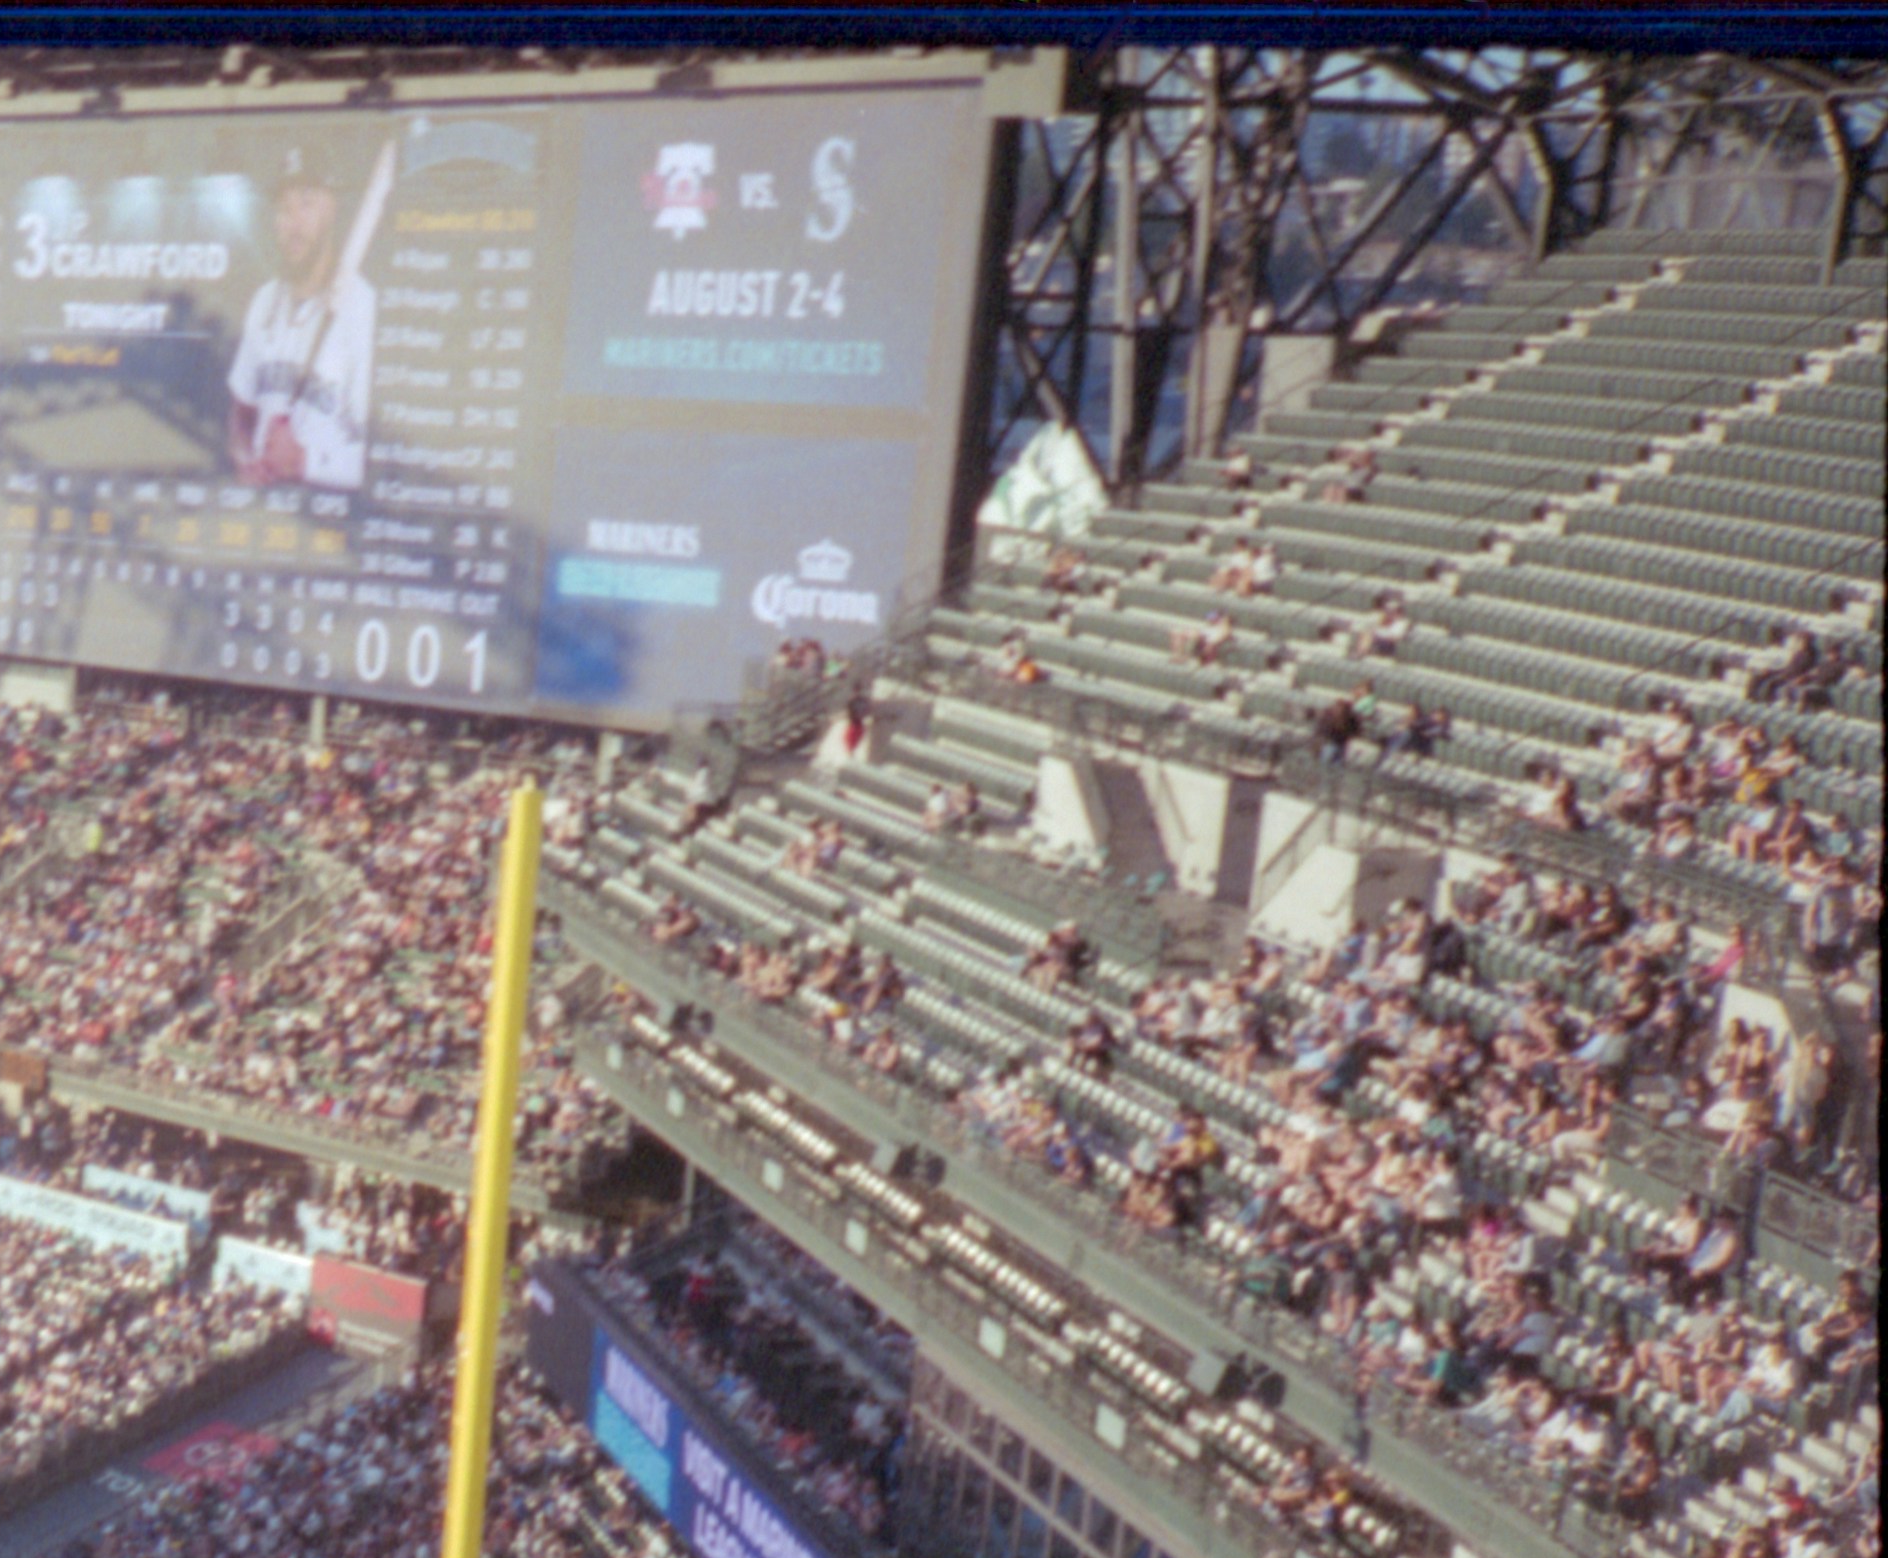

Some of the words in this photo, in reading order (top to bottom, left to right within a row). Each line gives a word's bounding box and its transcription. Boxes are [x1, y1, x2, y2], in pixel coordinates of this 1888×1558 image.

[13, 210, 50, 280] 3
[50, 241, 231, 280] CRAWFORD
[646, 269, 783, 318] AUGUST
[786, 270, 848, 320] 2-4
[750, 572, 881, 630] Corona
[355, 617, 391, 683] 0
[405, 622, 443, 689] 0
[463, 628, 488, 694] 1
